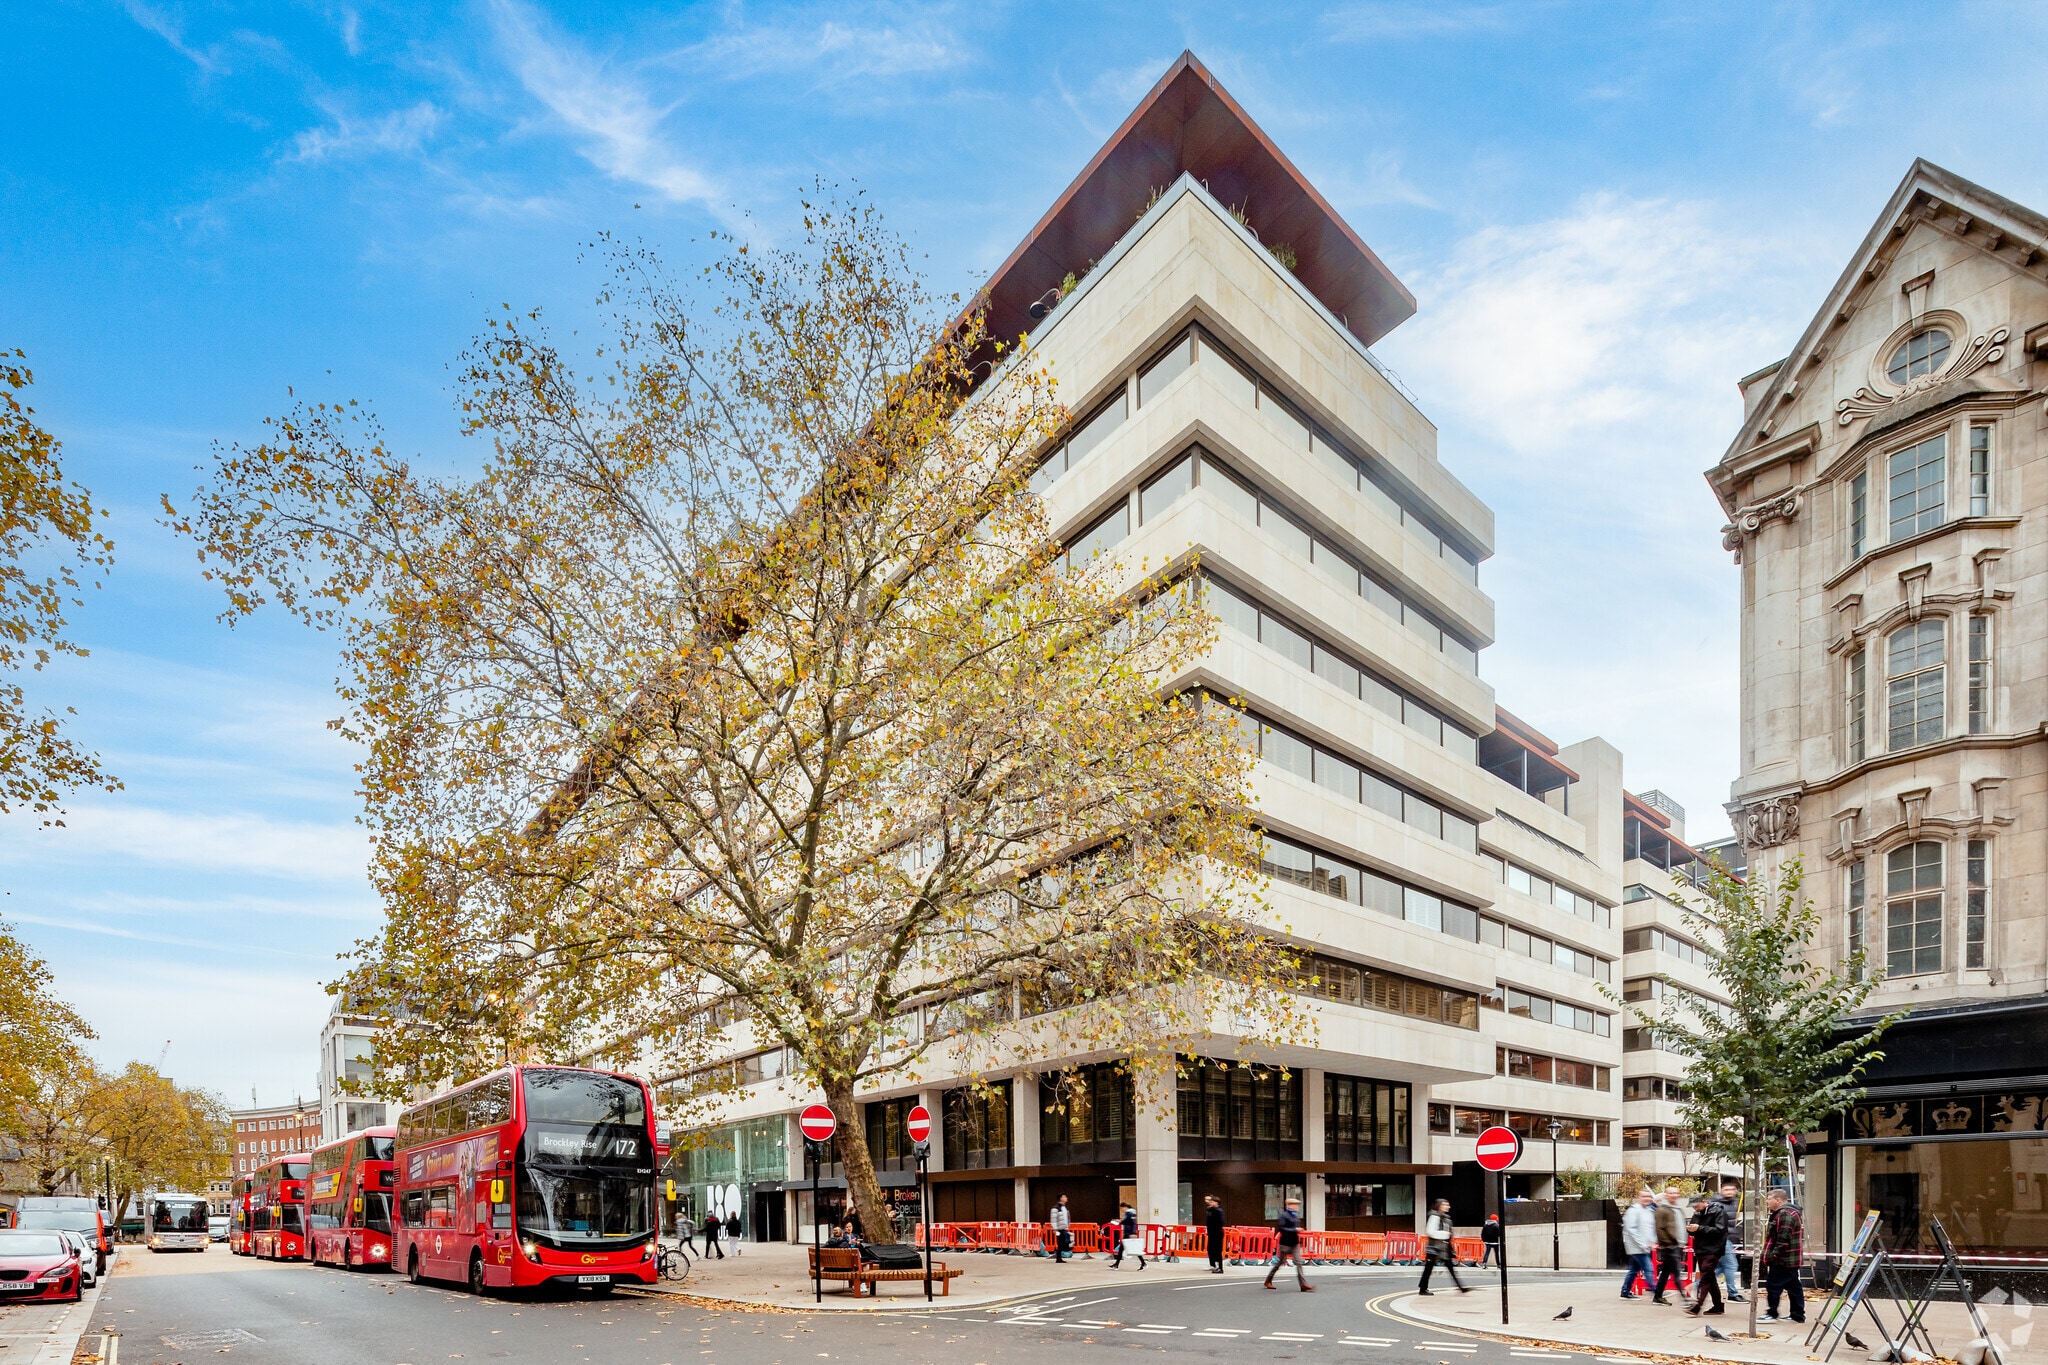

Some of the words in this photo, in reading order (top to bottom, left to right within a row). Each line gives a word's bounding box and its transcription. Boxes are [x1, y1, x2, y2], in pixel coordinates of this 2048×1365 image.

[544, 1136, 579, 1149] Brockley
[581, 1140, 597, 1149] Rise
[615, 1140, 636, 1156] 172
[894, 1189, 920, 1201] Broken
[706, 1183, 742, 1224] 180
